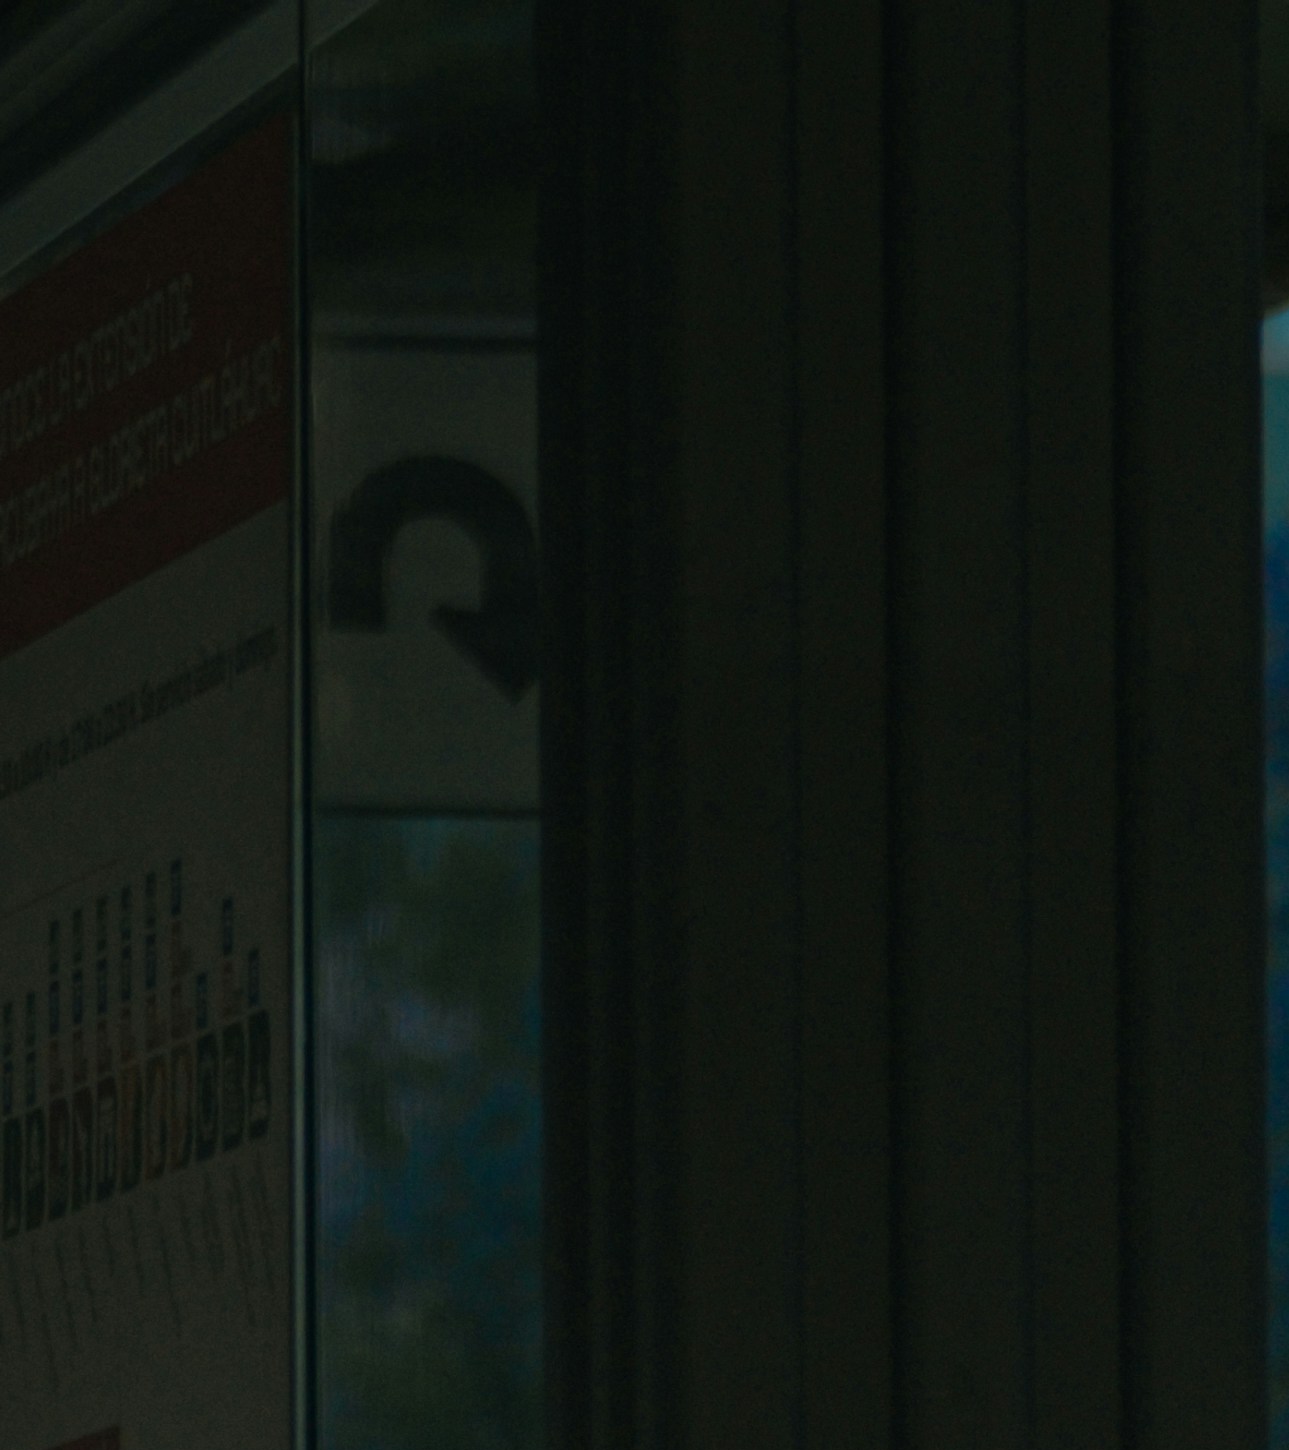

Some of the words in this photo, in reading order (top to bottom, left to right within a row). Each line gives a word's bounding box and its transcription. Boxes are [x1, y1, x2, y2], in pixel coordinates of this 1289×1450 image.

[0, 385, 46, 490] NOCE
[167, 271, 193, 351] DE
[0, 463, 70, 568] CUBAYA
